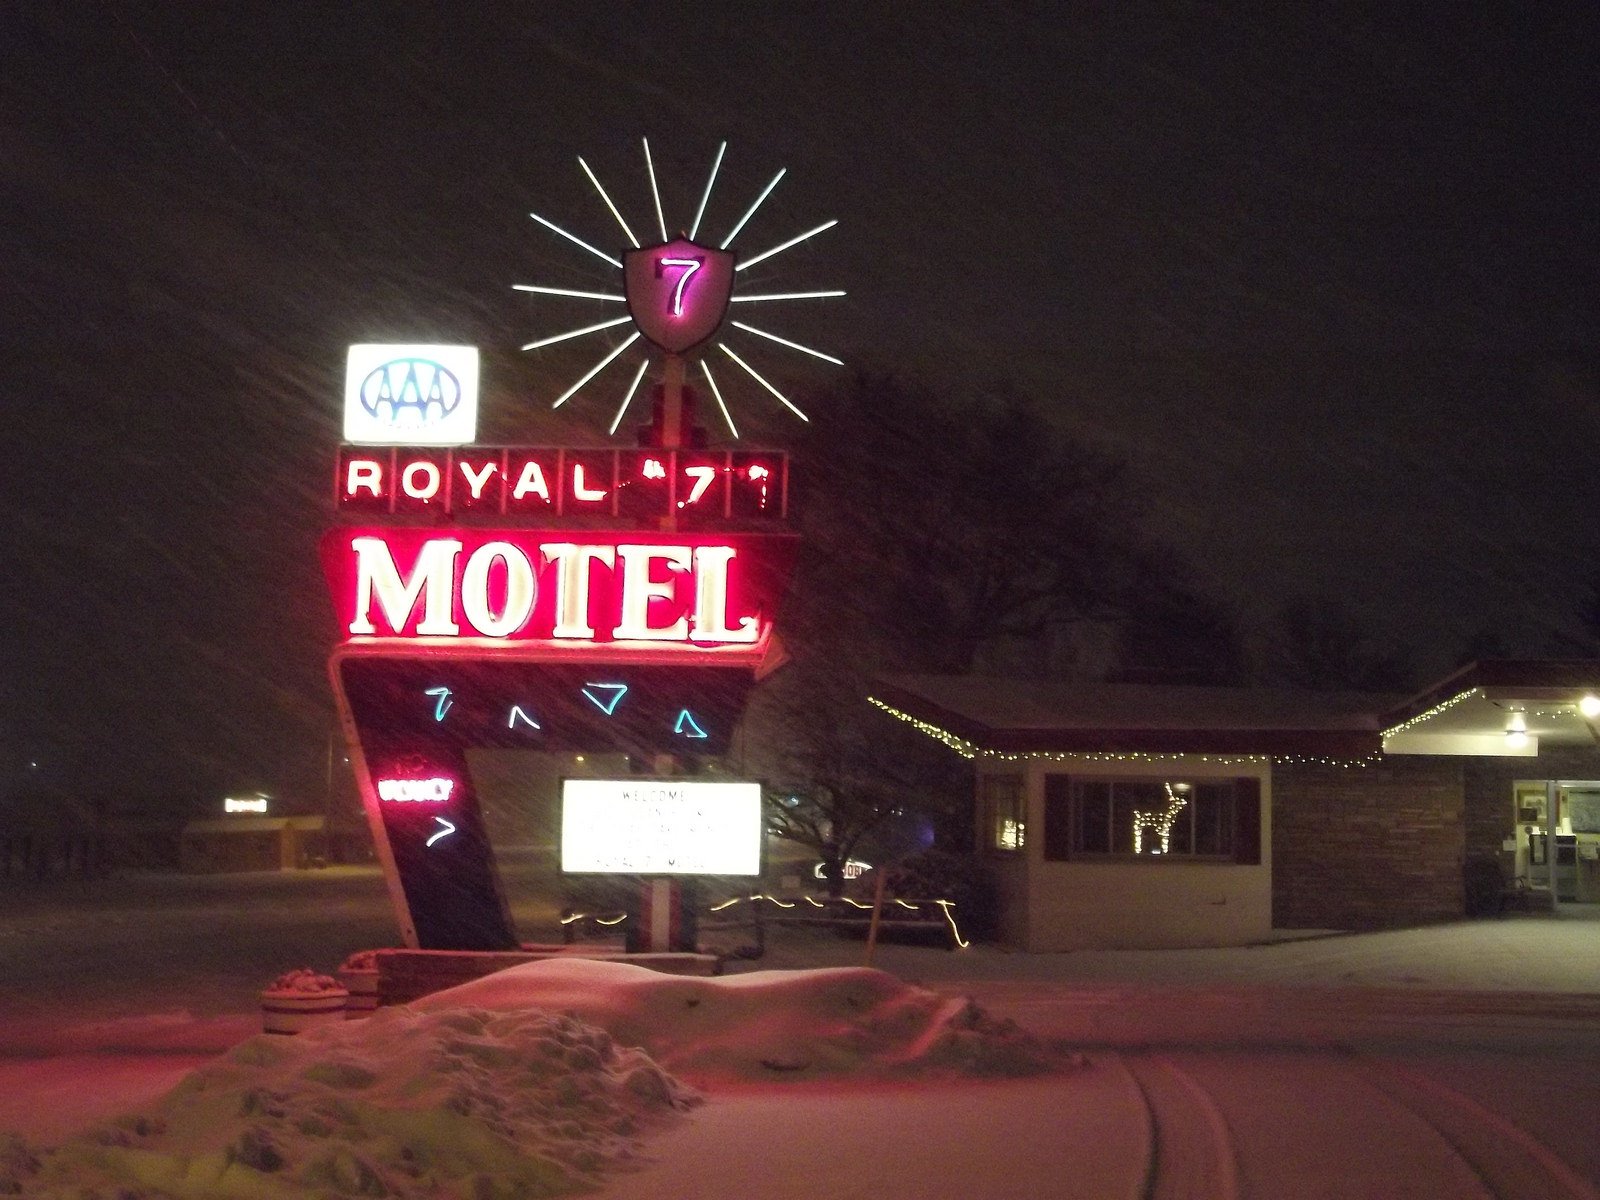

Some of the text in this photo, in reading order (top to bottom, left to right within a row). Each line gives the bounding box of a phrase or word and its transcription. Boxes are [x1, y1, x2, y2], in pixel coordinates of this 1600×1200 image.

[655, 257, 704, 315] 7
[369, 359, 452, 421] AAA
[346, 460, 608, 502] ROYAL
[350, 537, 761, 643] MOTEL
